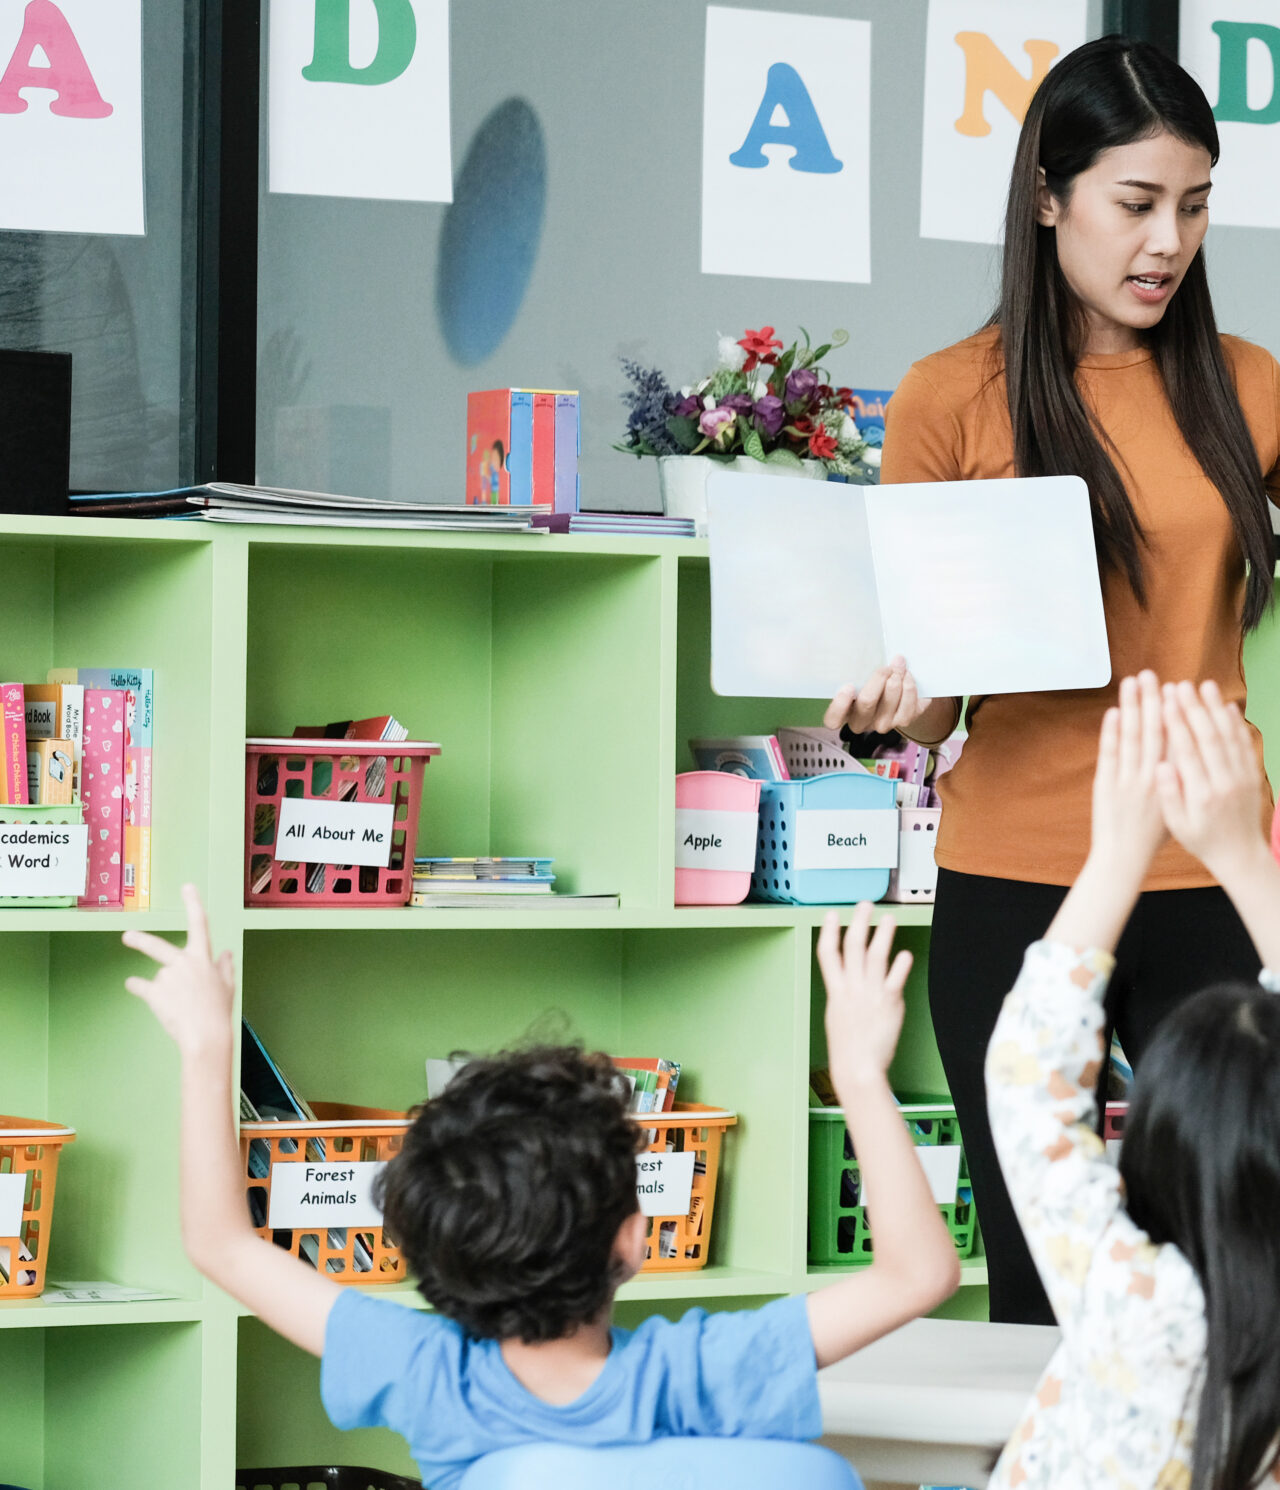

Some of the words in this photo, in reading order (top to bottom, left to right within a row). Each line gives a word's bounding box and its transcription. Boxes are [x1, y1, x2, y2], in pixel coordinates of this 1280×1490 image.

[301, 0, 417, 86] D
[0, 0, 114, 119] A
[954, 30, 1060, 138] N
[729, 62, 844, 174] A
[111, 673, 126, 687] Hello
[126, 673, 142, 691] Kitty
[25, 708, 33, 723] rd
[33, 708, 51, 723] Book
[72, 709, 79, 720] My
[11, 732, 20, 762] Chicka
[13, 763, 21, 792] Chicka
[0, 830, 70, 844] cademics
[285, 824, 305, 838] All
[312, 826, 355, 841] About
[362, 829, 384, 842] Me
[827, 833, 867, 847] Beach
[684, 833, 722, 850] Apple
[8, 854, 51, 868] Word
[637, 1159, 663, 1172] est
[305, 1168, 355, 1182] Forest
[637, 1181, 664, 1194] mals
[300, 1190, 357, 1205] Animals
